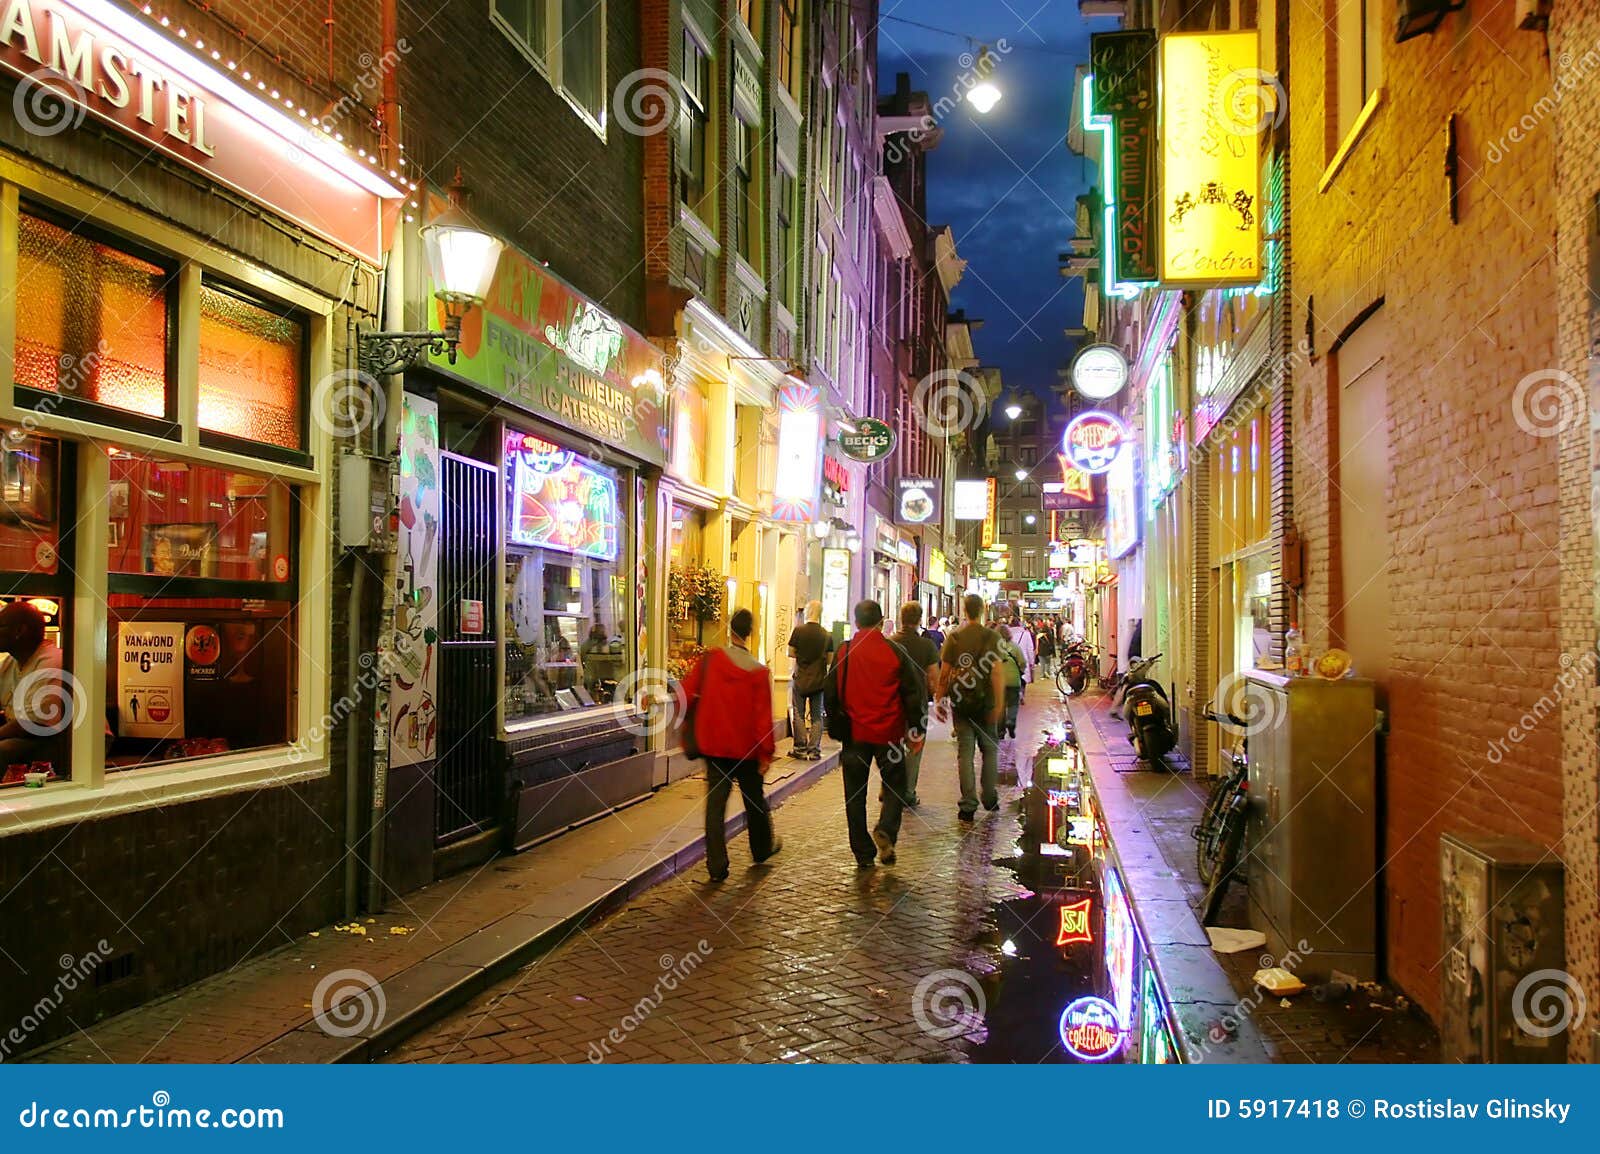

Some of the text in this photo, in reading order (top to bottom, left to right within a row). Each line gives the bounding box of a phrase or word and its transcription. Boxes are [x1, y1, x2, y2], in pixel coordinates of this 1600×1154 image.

[0, 0, 216, 159] AMSTEL
[1119, 117, 1143, 253] FREELAND
[1169, 249, 1257, 271] Centra
[504, 363, 627, 442] DELICATESSEN
[555, 360, 633, 418] PRIMEURS
[844, 434, 889, 446] BECK'S
[125, 635, 174, 647] VANAVOND
[124, 651, 173, 673] OM 6 UUR
